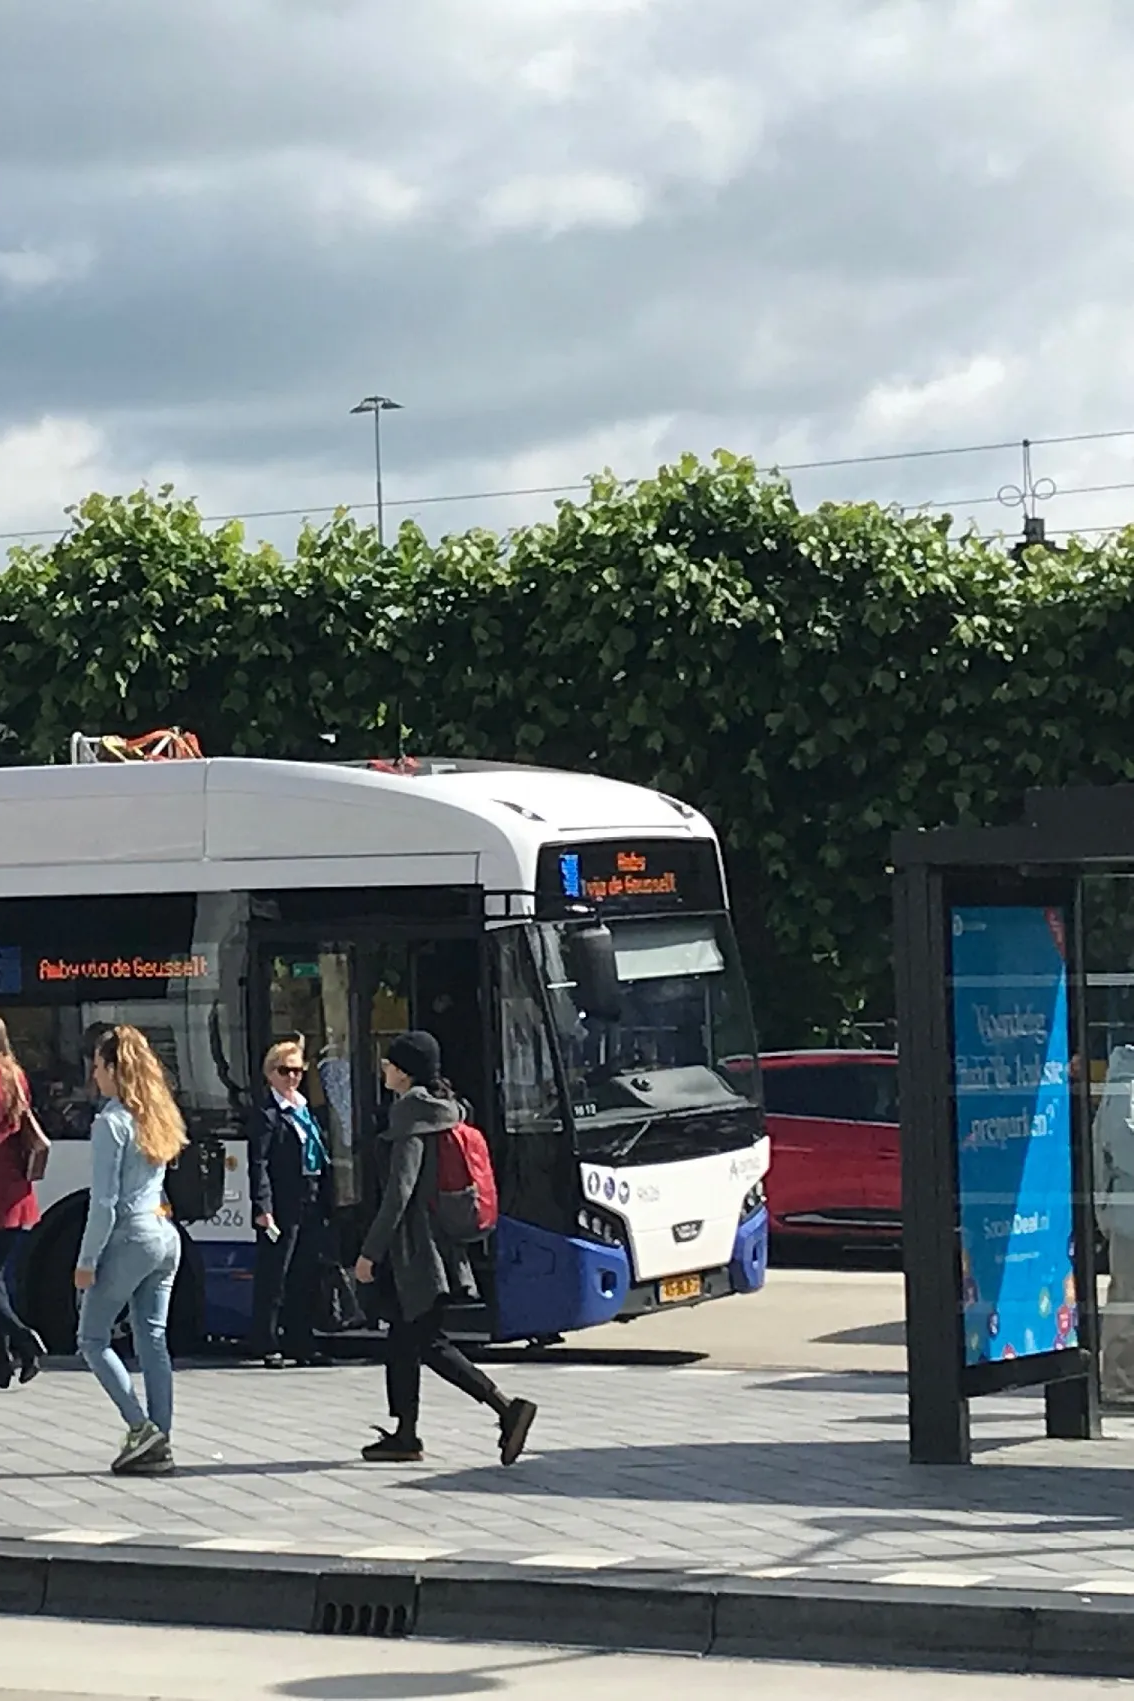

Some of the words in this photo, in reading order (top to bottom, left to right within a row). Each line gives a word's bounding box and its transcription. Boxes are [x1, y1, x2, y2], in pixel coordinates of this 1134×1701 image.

[111, 957, 131, 978] de
[133, 956, 209, 978] Geusselt
[203, 1209, 244, 1228] 626
